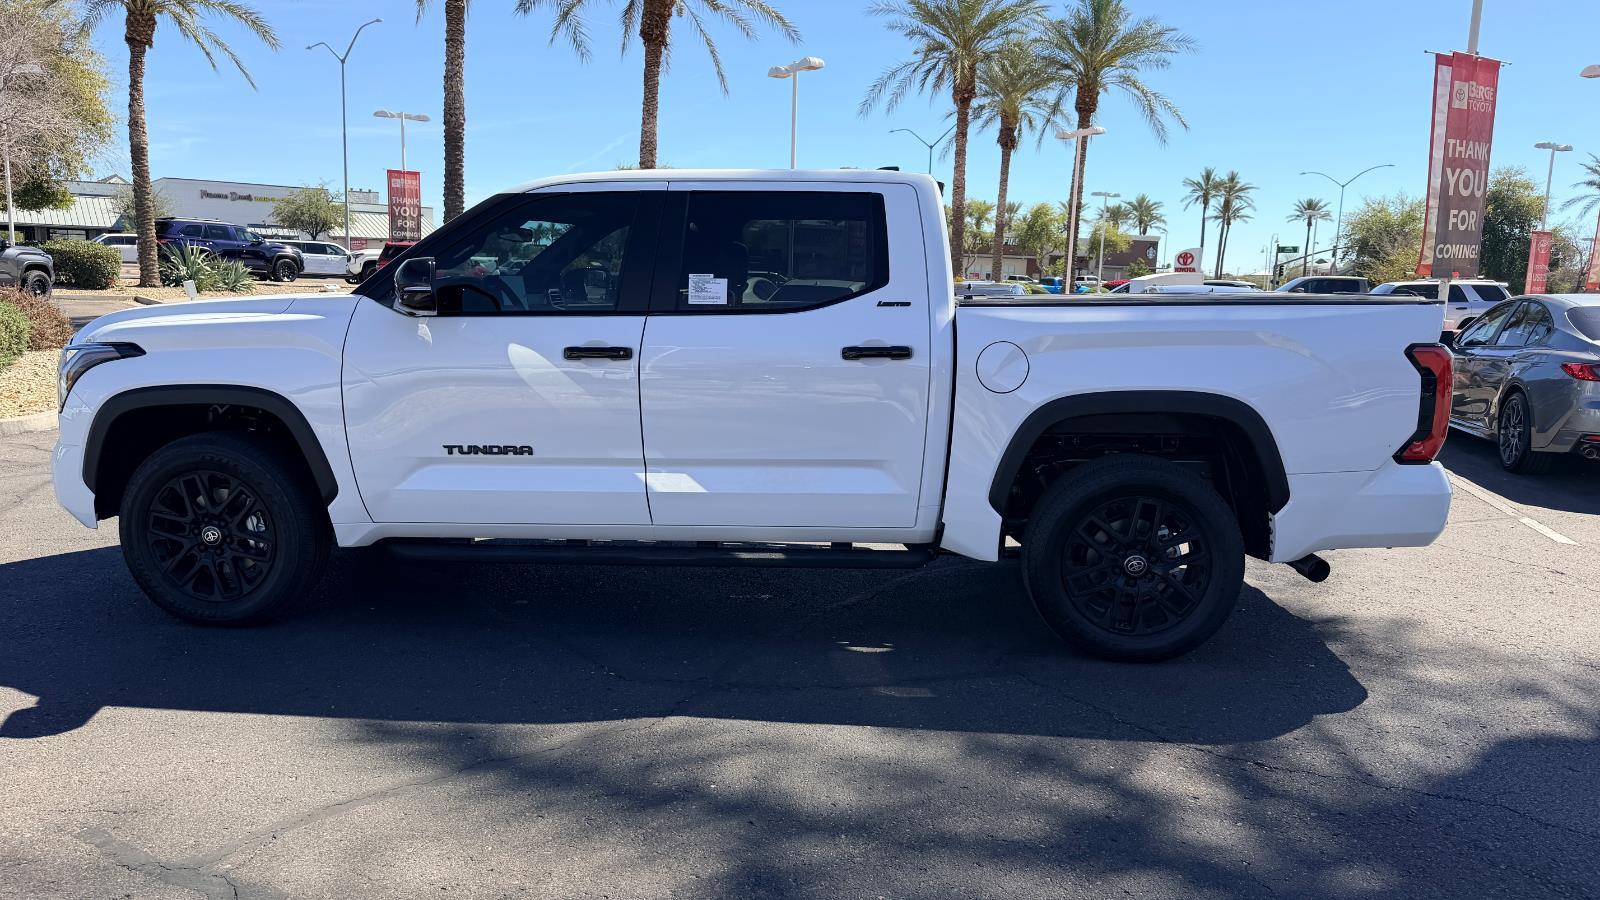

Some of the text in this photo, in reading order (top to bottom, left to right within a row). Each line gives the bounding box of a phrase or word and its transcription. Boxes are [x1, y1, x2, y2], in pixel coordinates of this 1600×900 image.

[1469, 81, 1494, 101] BERGE
[1468, 100, 1492, 112] TOYOTA
[1447, 139, 1490, 160] THANK
[1446, 167, 1486, 197] YOU
[392, 197, 419, 205] THANK
[393, 206, 418, 217] YOU
[397, 219, 415, 228] FOR
[1448, 209, 1477, 231] FOR
[392, 230, 420, 238] COMING!
[1436, 244, 1478, 259] COMING!
[442, 445, 533, 456] TUNDRA
